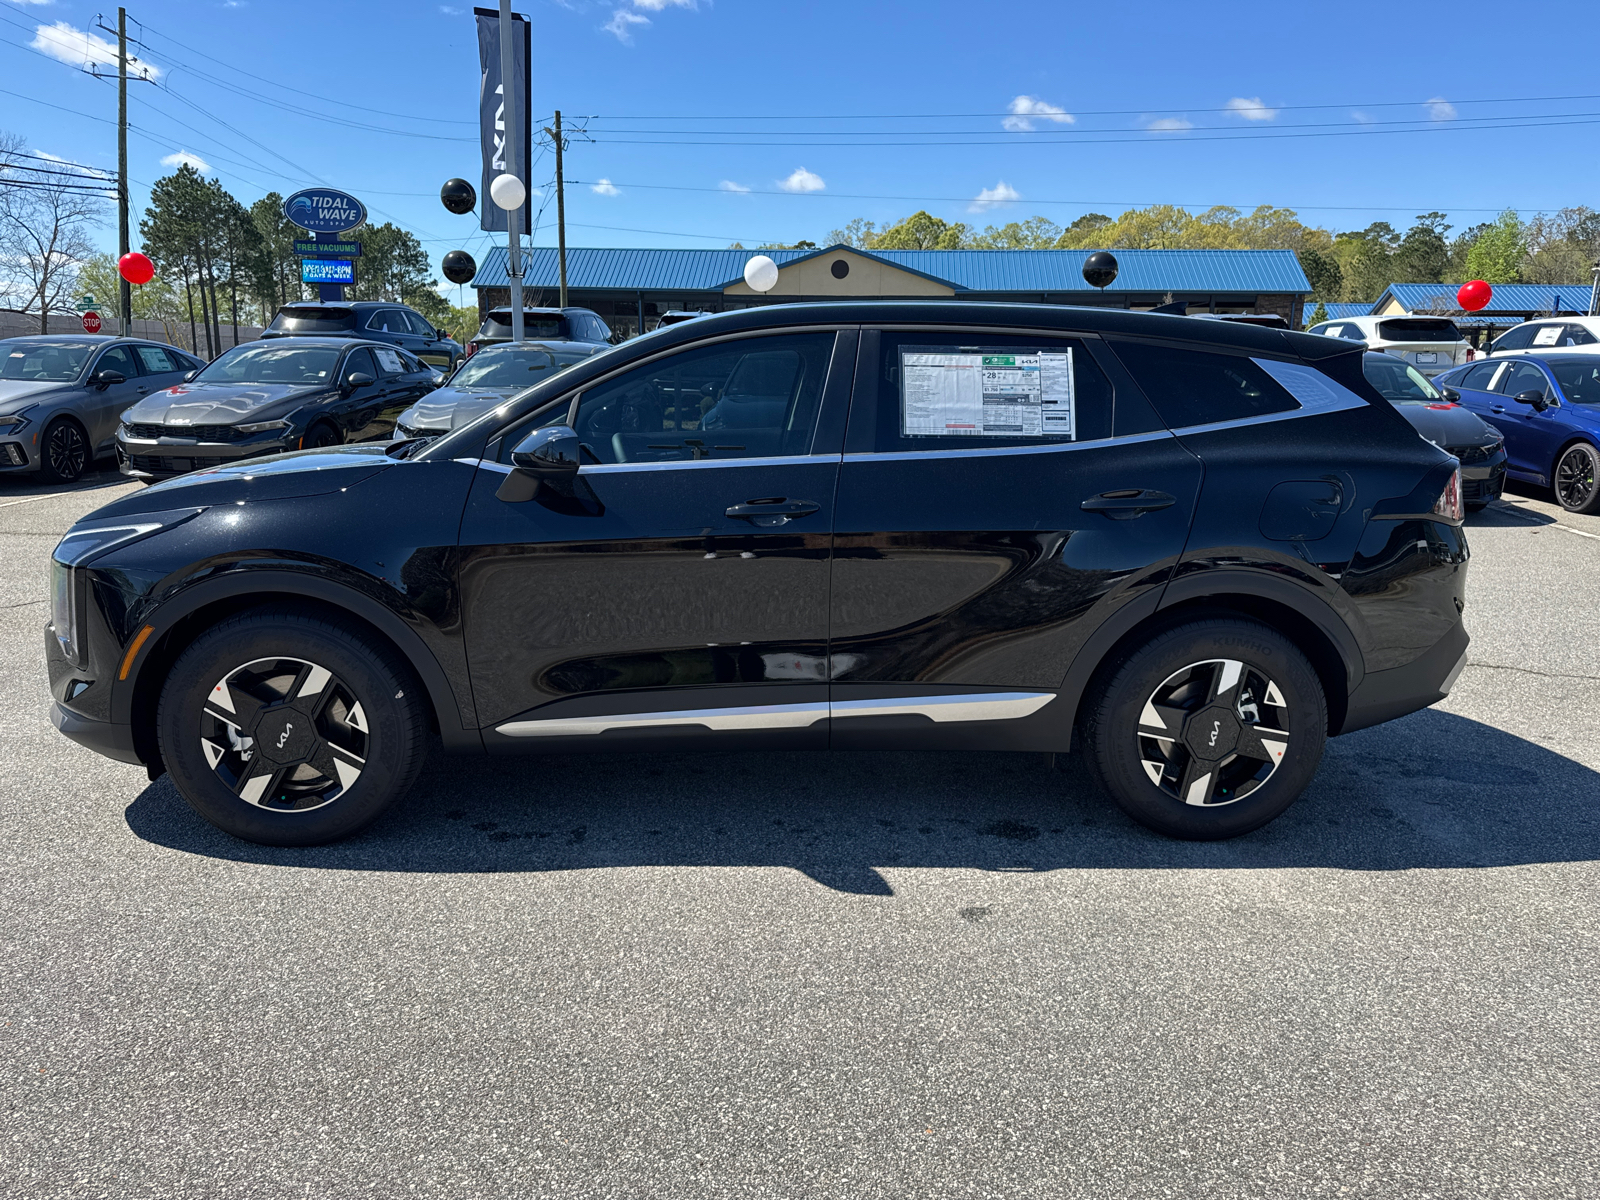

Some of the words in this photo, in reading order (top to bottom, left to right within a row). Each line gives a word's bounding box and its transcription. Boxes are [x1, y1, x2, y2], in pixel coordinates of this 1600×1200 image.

[312, 197, 349, 209] TIDAL
[319, 208, 357, 220] WAVE
[296, 243, 317, 252] FREE
[319, 244, 356, 253] VACUUMS
[83, 318, 100, 328] STOP
[986, 371, 997, 379] 28
[1212, 637, 1273, 657] KUMHO
[276, 722, 293, 749] KIA
[1208, 720, 1221, 747] KIA
